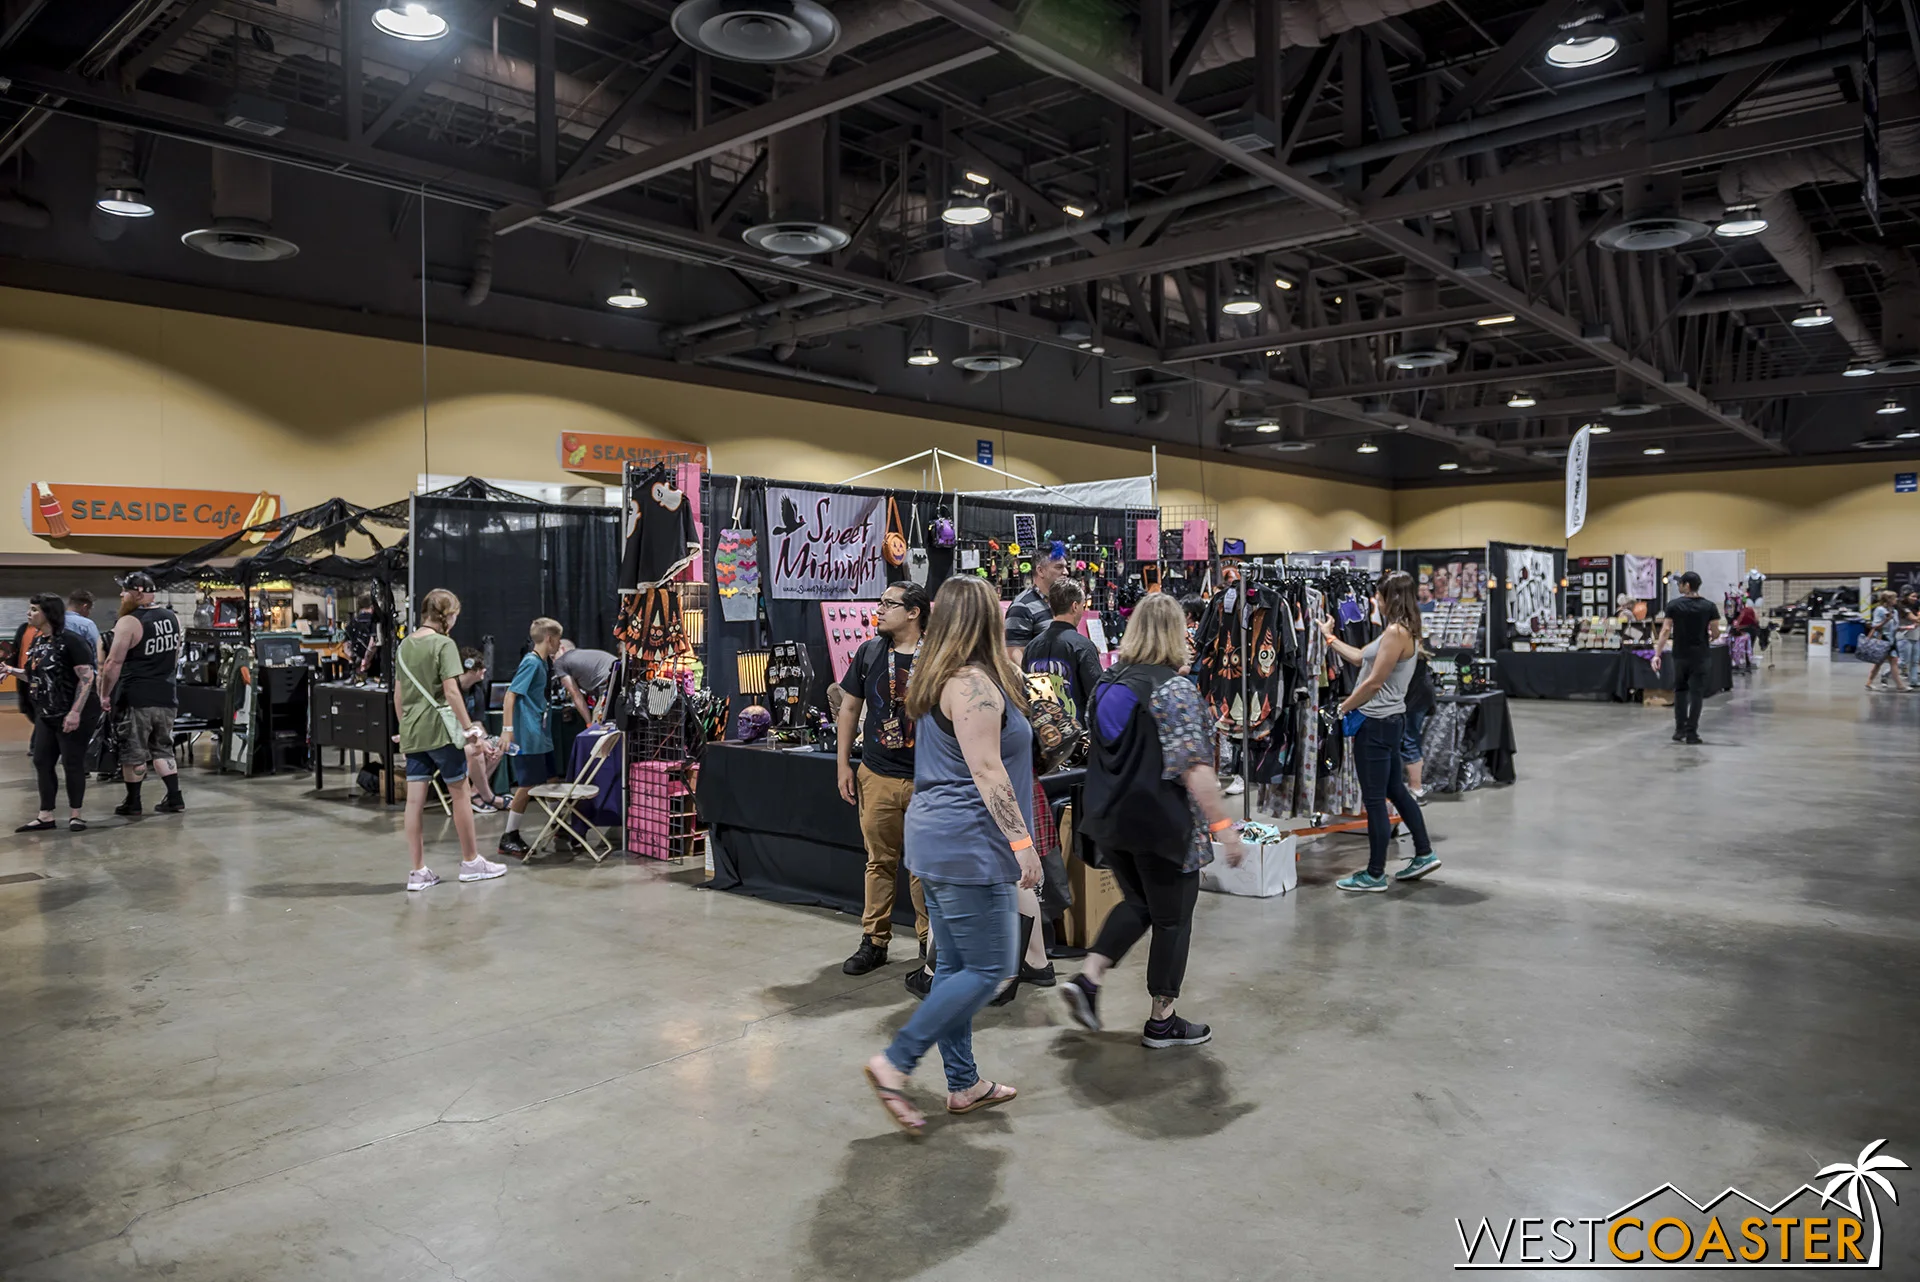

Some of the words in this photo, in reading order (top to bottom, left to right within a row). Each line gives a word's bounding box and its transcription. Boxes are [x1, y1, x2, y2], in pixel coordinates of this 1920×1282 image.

[592, 444, 664, 464] SEASIDE
[71, 499, 188, 523] SEASIDE
[193, 503, 241, 530] Cafe
[806, 497, 873, 543] Sweet
[774, 537, 883, 595] Midnight
[153, 618, 173, 636] NO
[144, 633, 179, 656] GODS
